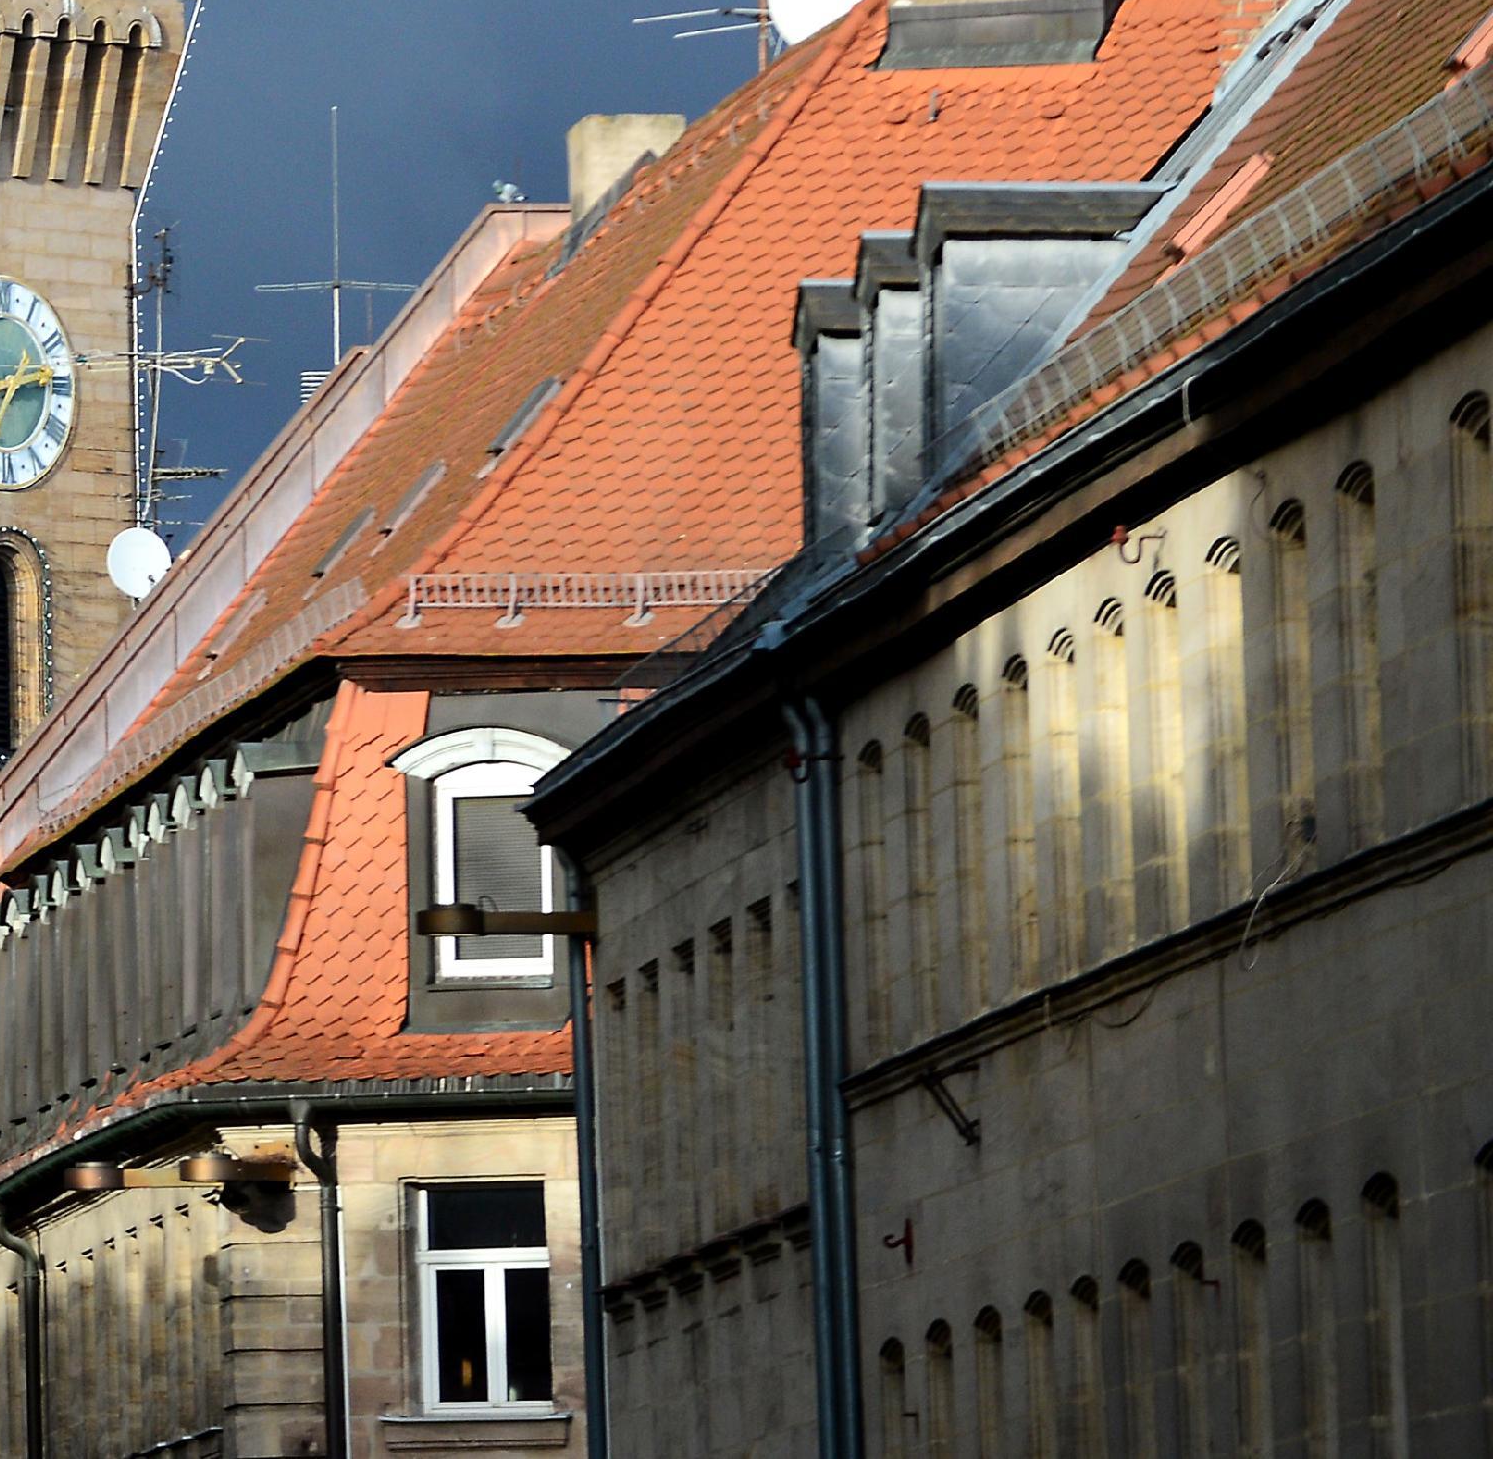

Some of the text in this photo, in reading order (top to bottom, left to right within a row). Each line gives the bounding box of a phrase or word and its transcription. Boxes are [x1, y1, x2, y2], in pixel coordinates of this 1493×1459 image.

[26, 296, 40, 322] I
[42, 328, 64, 353] II
[27, 446, 46, 476] V
